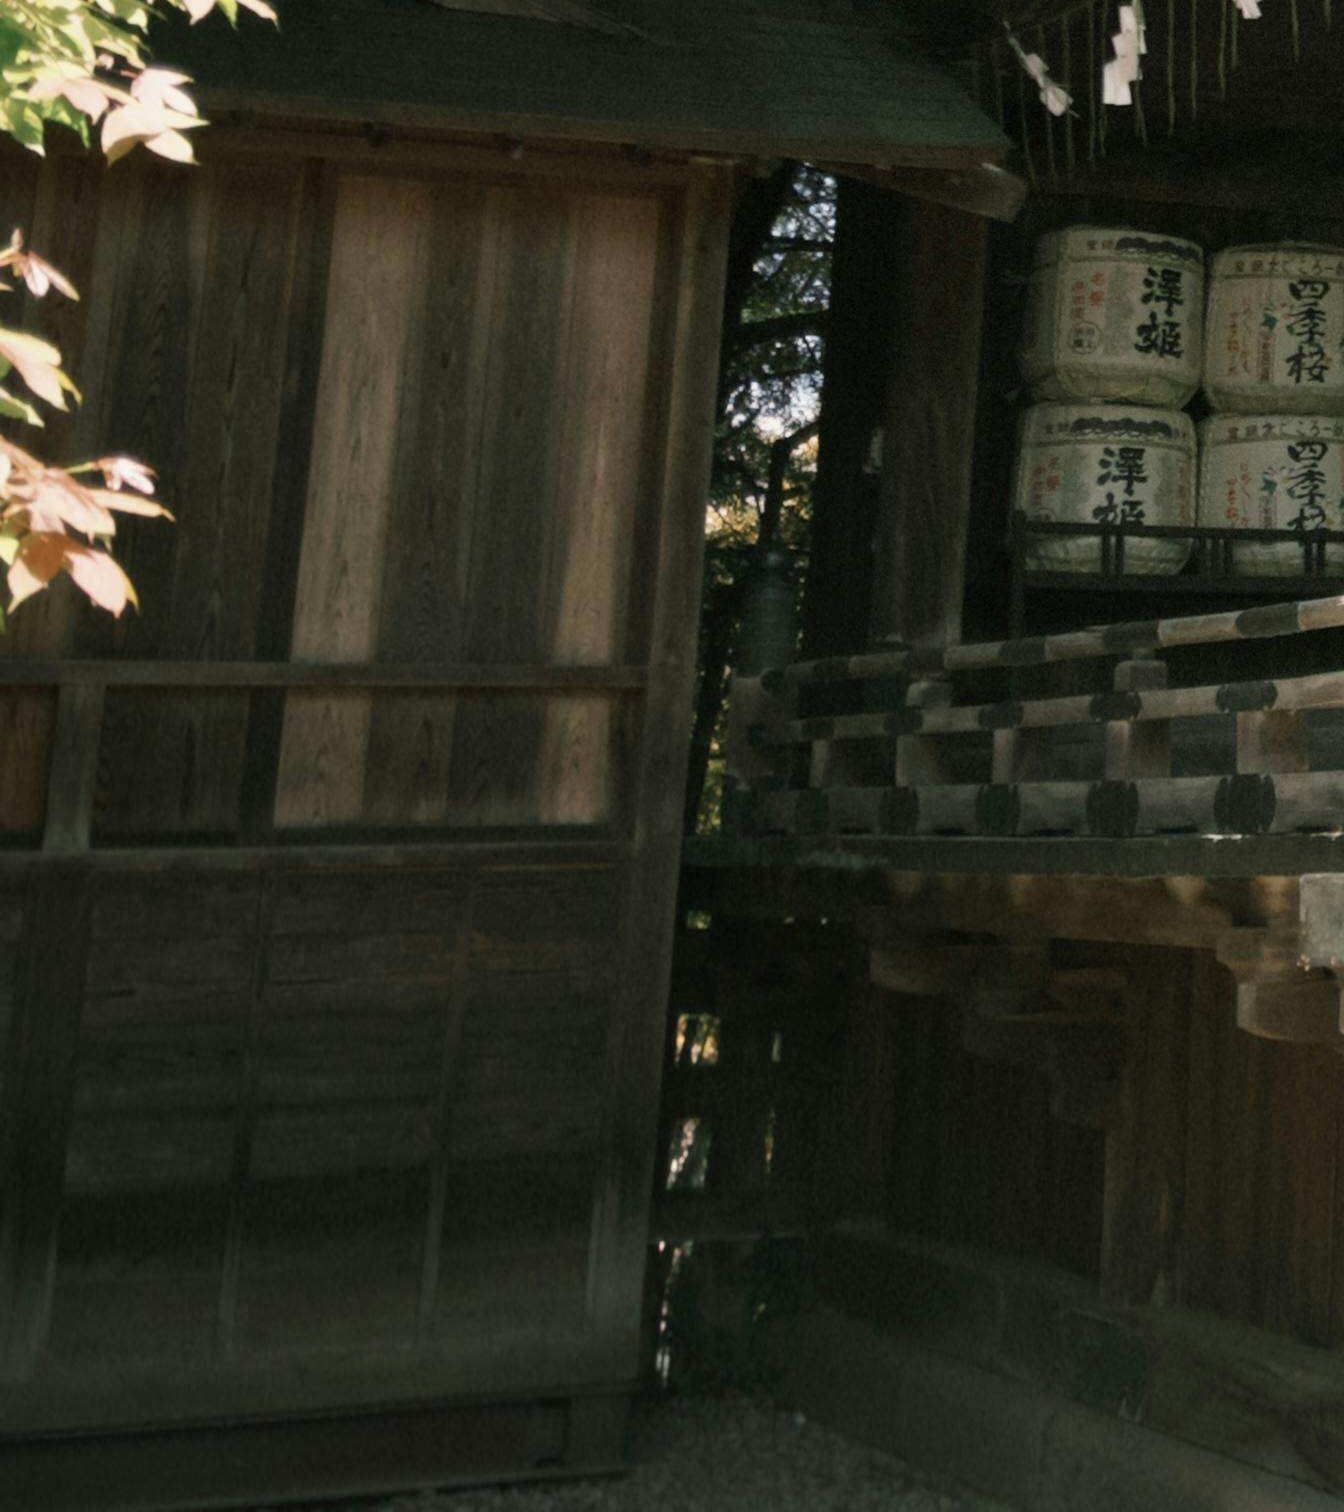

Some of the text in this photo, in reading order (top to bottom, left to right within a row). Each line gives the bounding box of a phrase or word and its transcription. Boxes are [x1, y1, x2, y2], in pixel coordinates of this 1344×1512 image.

[1134, 266, 1184, 360] 澤姫
[1285, 279, 1330, 385] 四季桜
